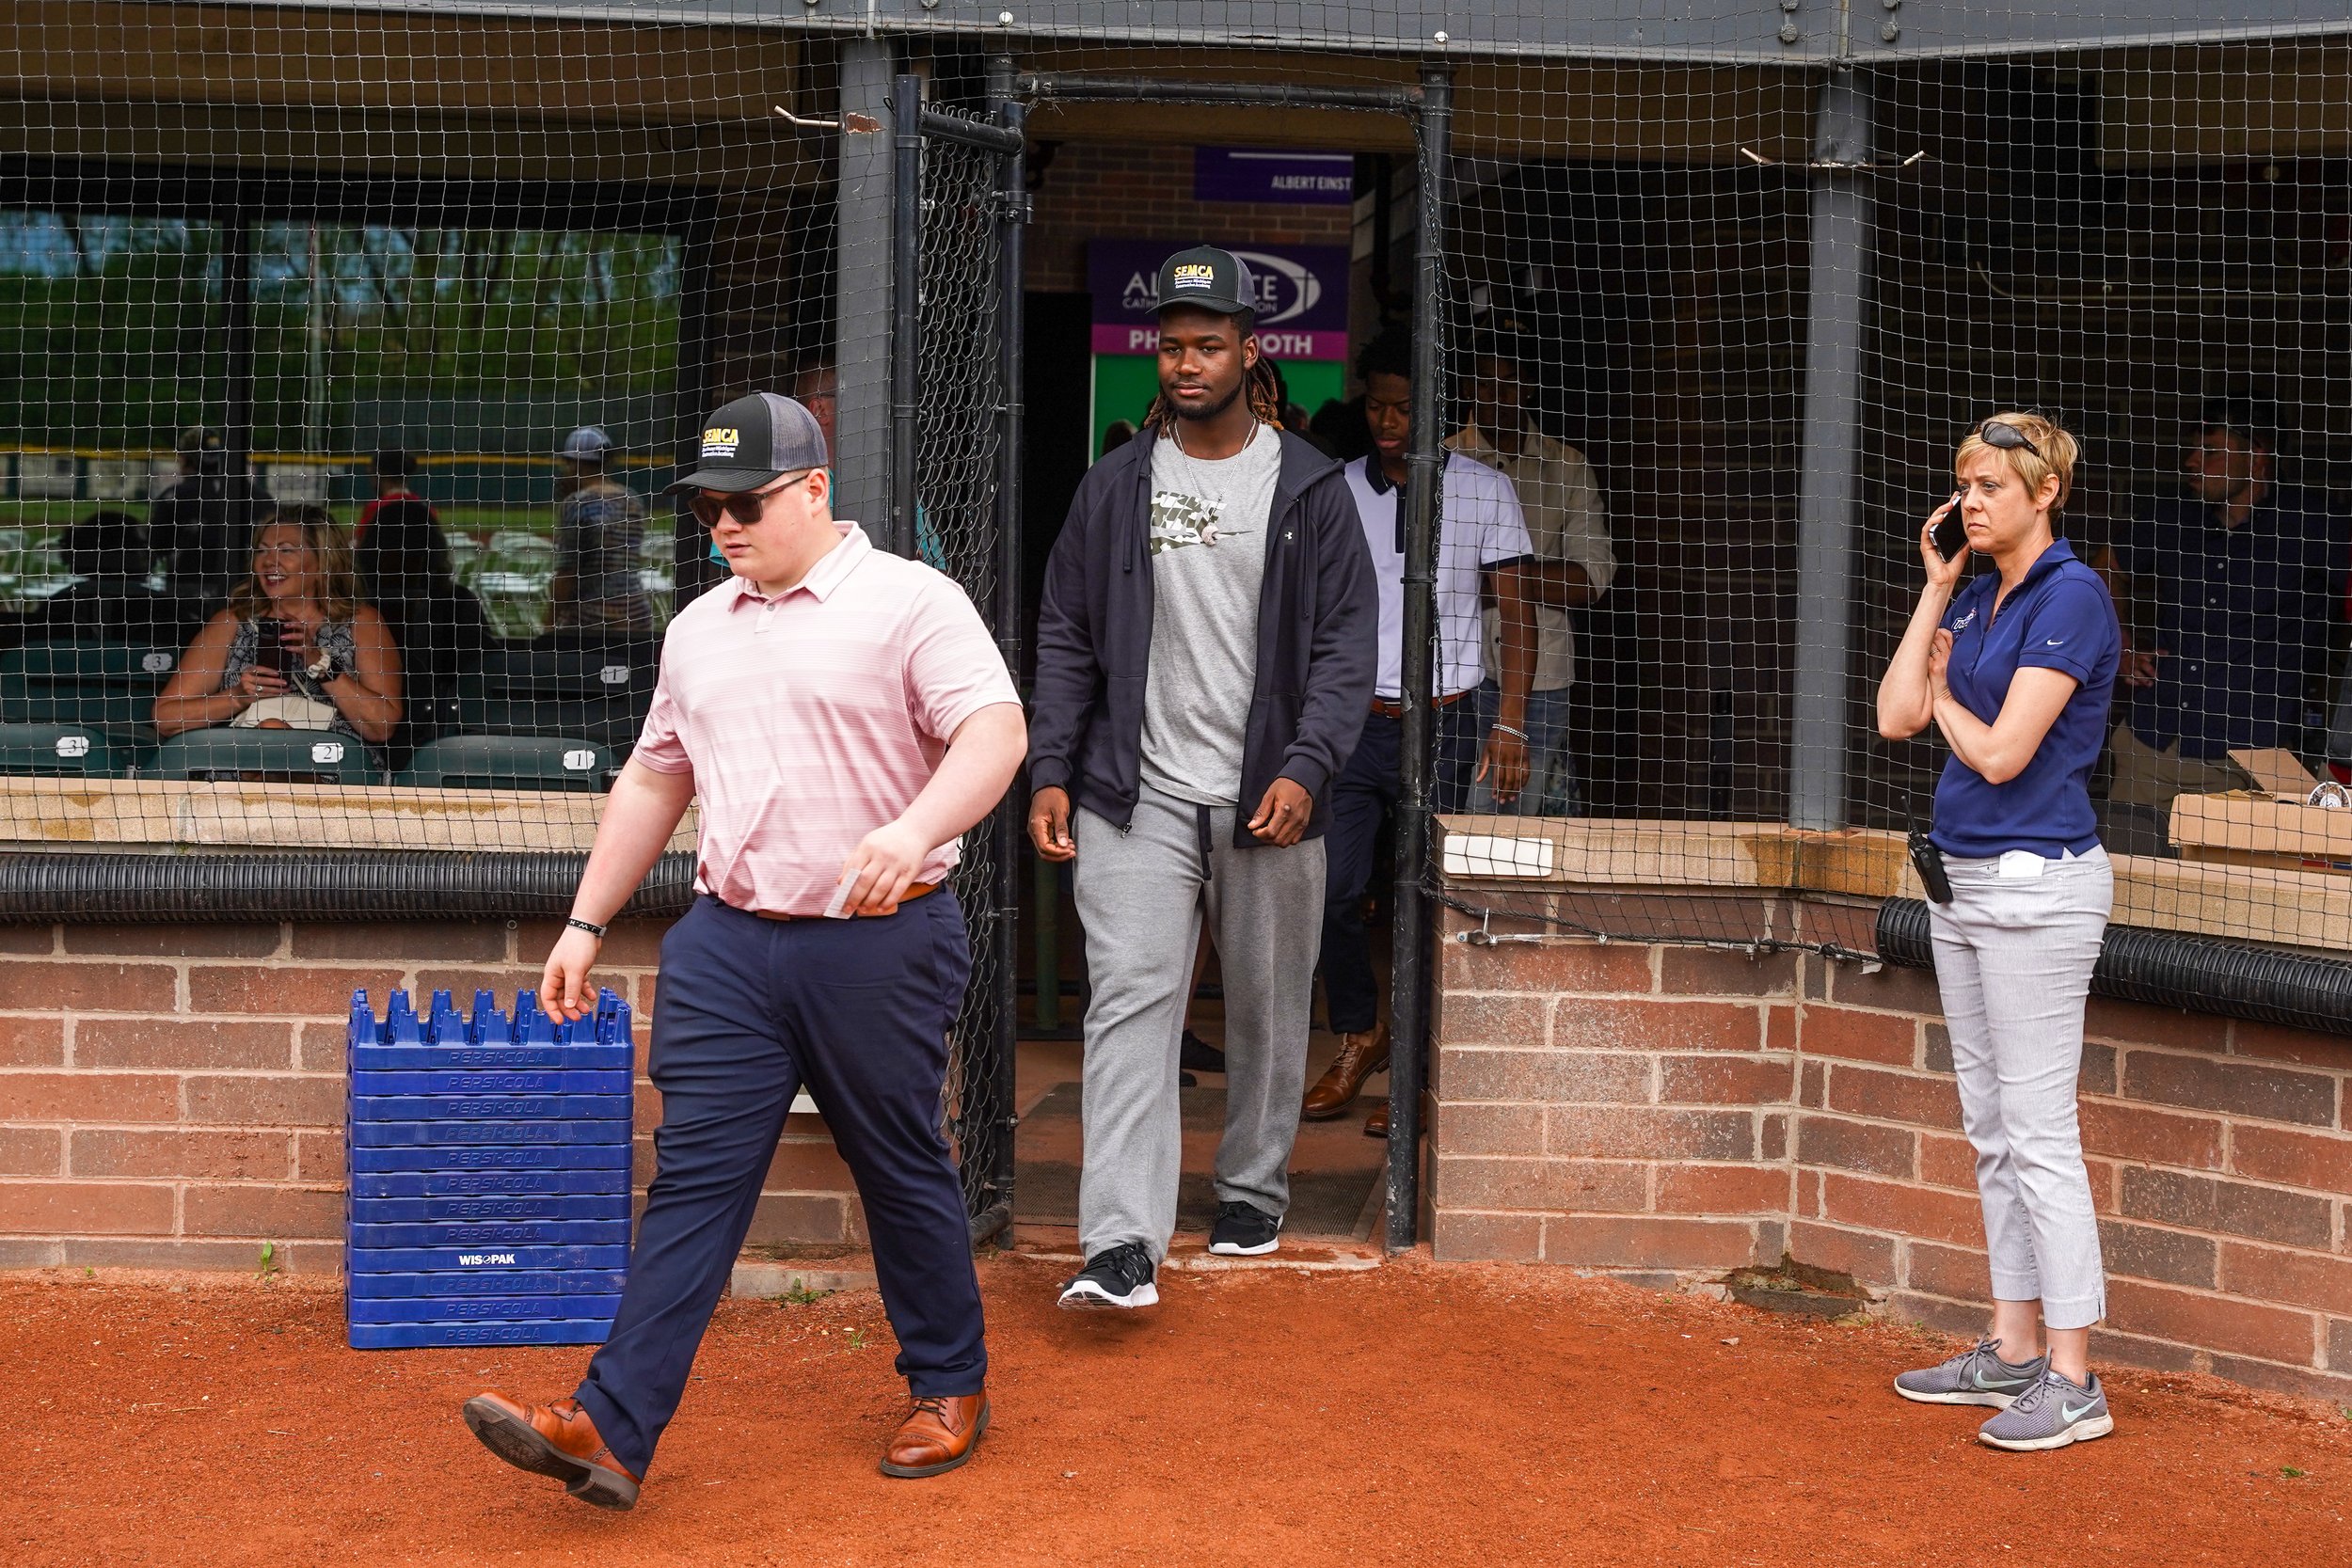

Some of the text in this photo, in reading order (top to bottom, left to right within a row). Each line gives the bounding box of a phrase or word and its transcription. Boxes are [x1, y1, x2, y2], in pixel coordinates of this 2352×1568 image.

[1271, 176, 1352, 190] ALBERT EINST
[1173, 264, 1214, 278] SEMCA
[703, 428, 739, 443] SEMCA
[152, 656, 161, 669] 3
[68, 739, 76, 753] 3
[323, 745, 332, 760] 2
[448, 1052, 544, 1064] PEPSI-COLA
[447, 1077, 543, 1089] PEPSI-COLA
[446, 1102, 542, 1115] PEPSI-COLA
[446, 1152, 543, 1164] PEPSI-COLA
[446, 1178, 542, 1190] PEPSI-COLA
[445, 1203, 542, 1215] PEPSI-COLA
[445, 1227, 542, 1241] PEPSI-COLA
[444, 1303, 542, 1315] PEPSI-COLA
[444, 1327, 542, 1341] PEPSI-COLA
